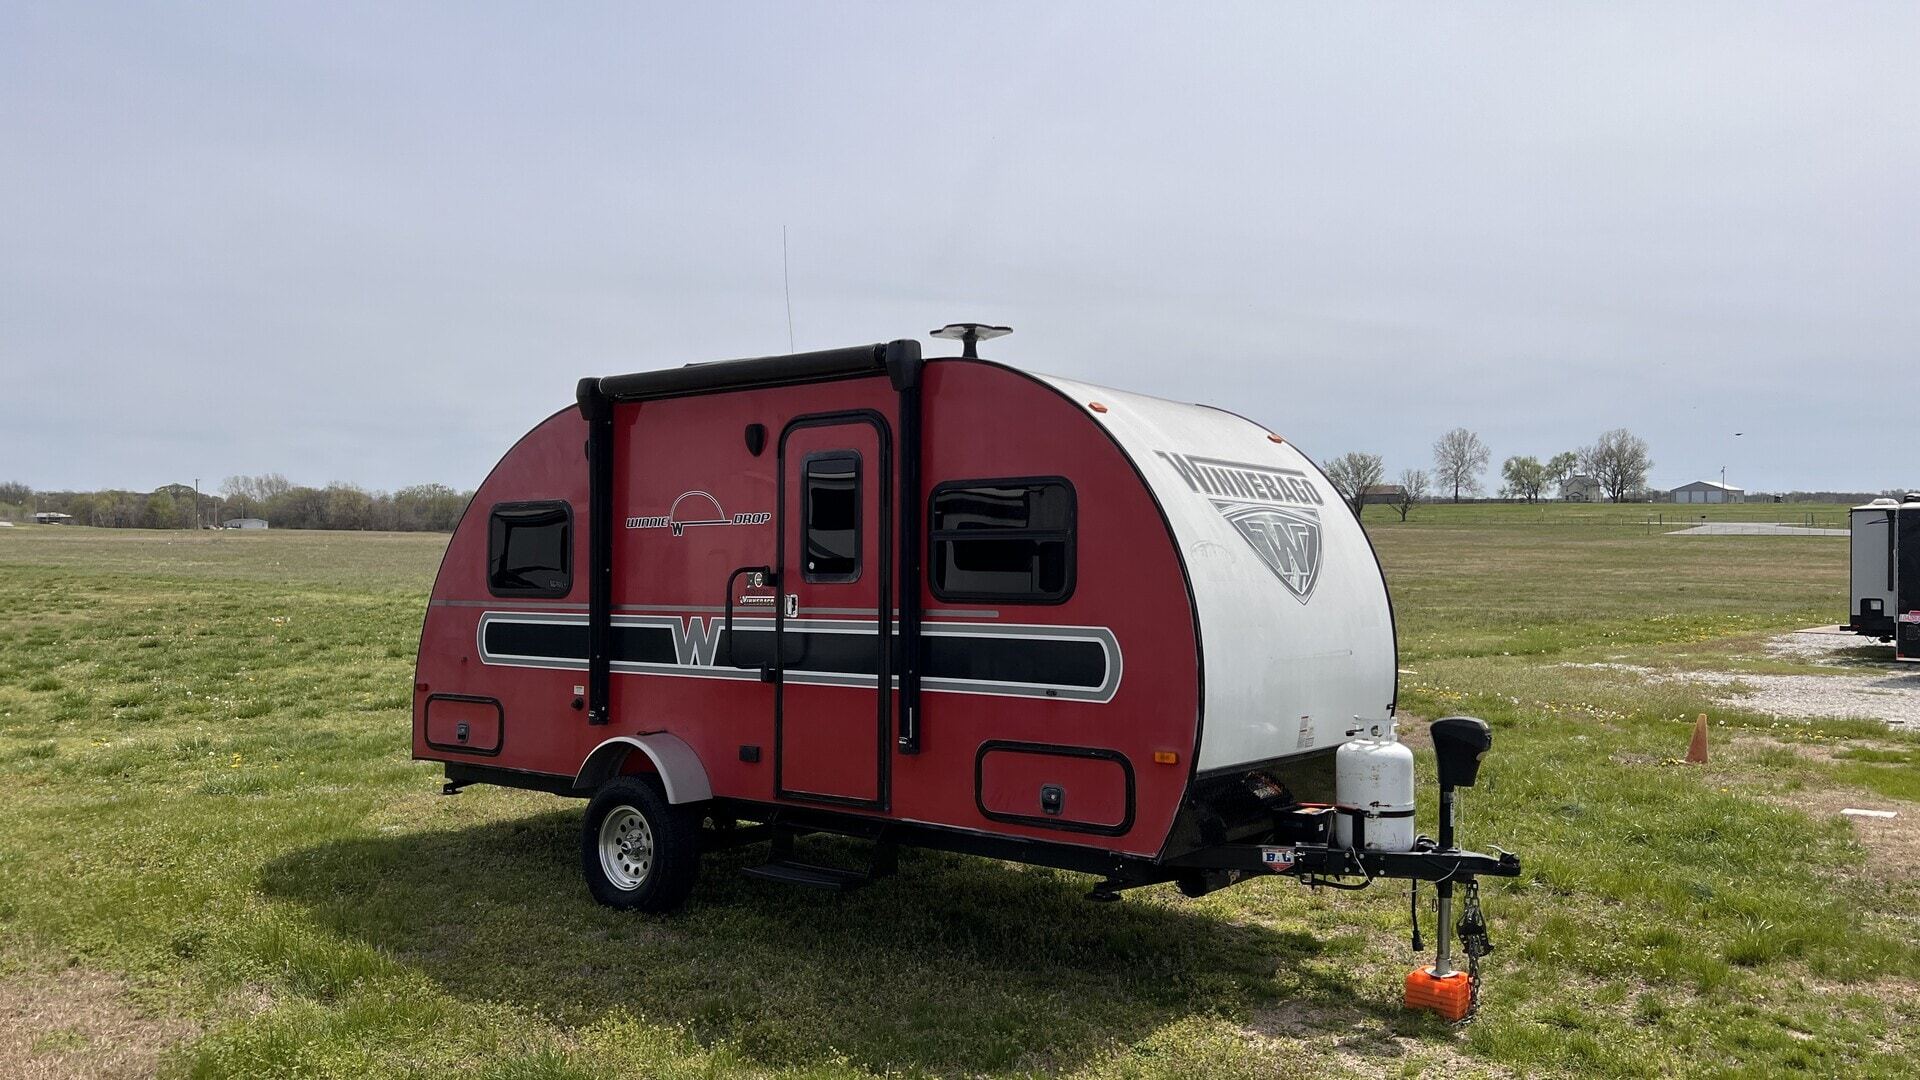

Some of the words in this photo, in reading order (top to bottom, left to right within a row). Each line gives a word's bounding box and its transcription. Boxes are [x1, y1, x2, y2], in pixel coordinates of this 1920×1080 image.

[1152, 450, 1324, 506] WINNEBAGO
[626, 515, 670, 529] WINNIE
[733, 513, 771, 525] DROP
[670, 521, 684, 536] W
